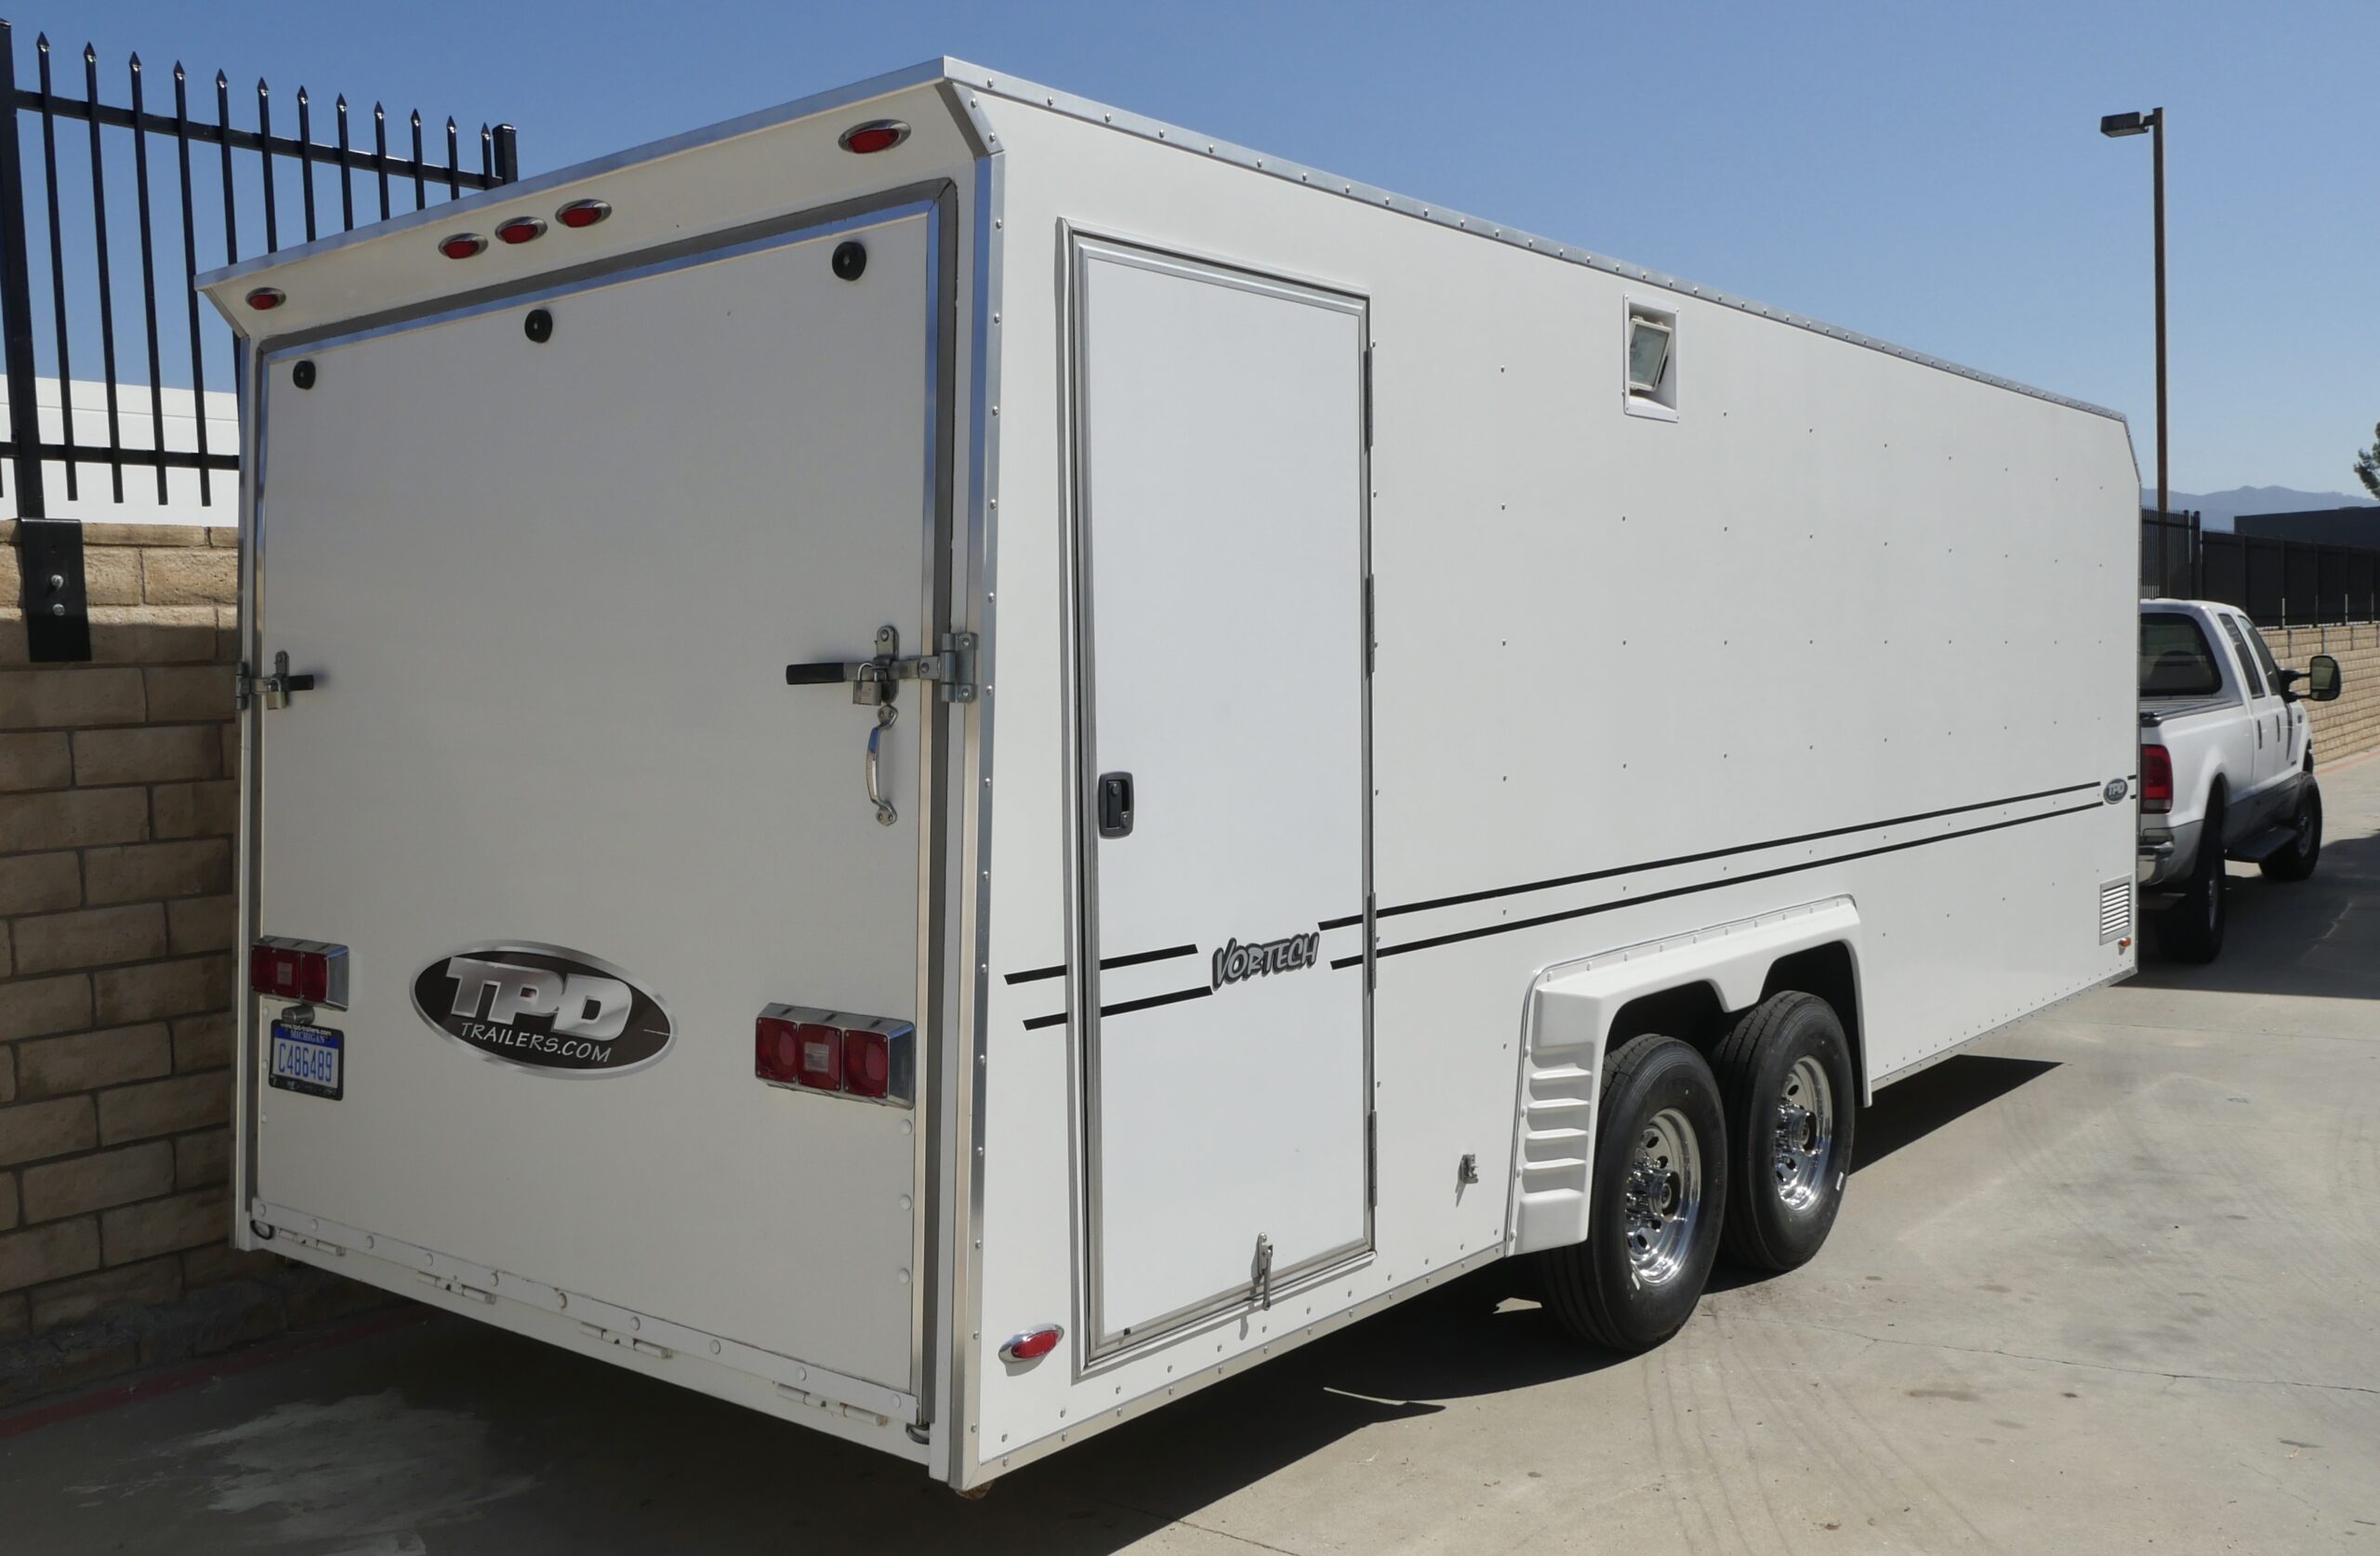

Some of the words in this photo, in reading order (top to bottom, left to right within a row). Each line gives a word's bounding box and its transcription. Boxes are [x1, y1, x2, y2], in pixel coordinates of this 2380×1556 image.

[2108, 781, 2125, 796] TPD
[1212, 931, 1320, 991] VORTECH
[445, 956, 633, 1041] TPD
[290, 1030, 325, 1044] MICHIGAN
[461, 1022, 612, 1062] TRAILERS.COM
[278, 1043, 332, 1082] C486489
